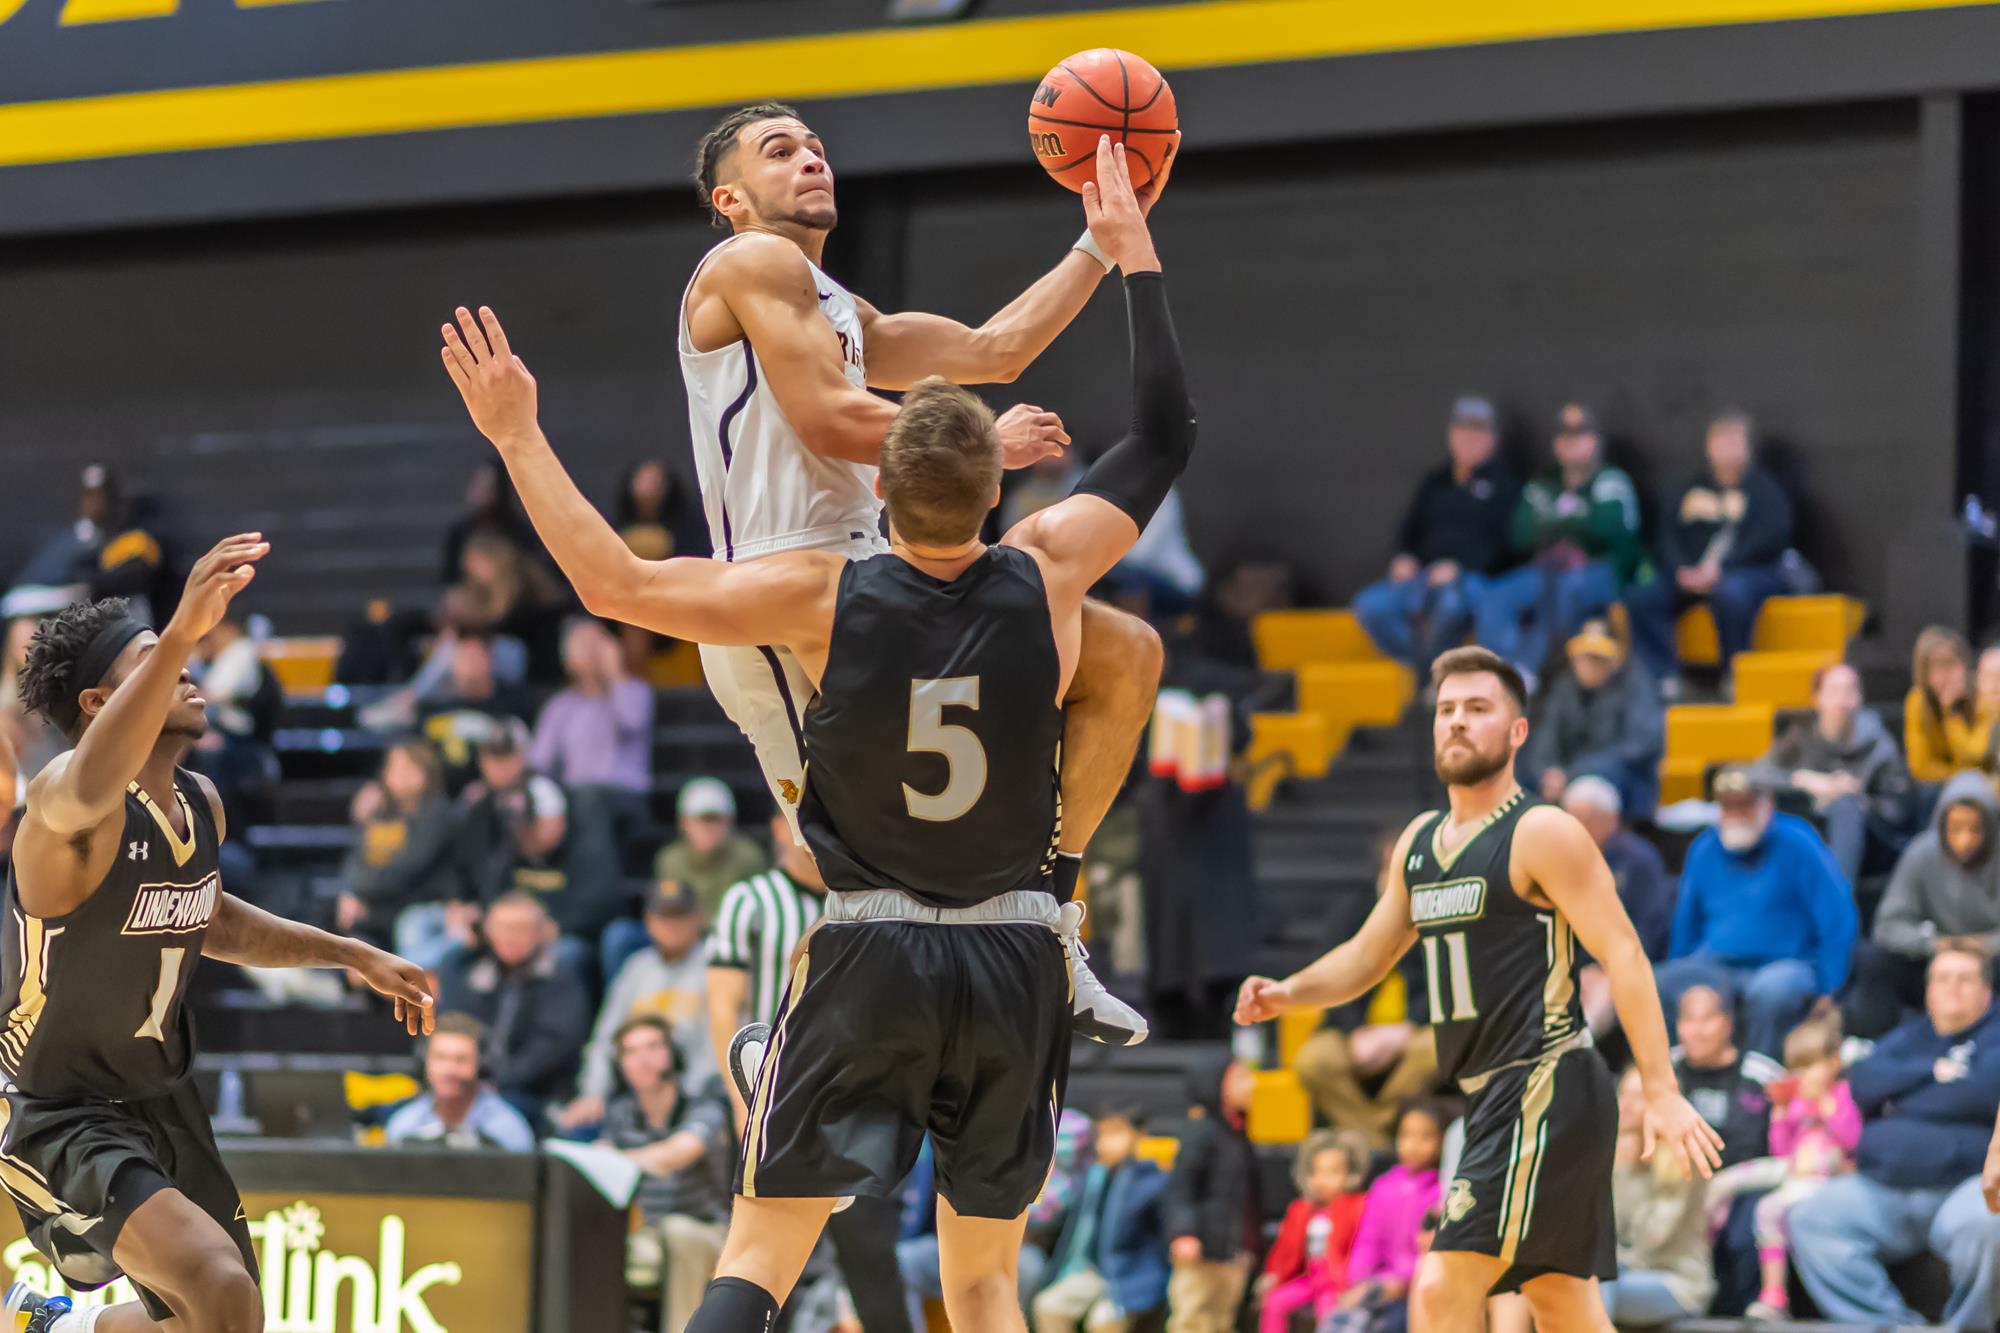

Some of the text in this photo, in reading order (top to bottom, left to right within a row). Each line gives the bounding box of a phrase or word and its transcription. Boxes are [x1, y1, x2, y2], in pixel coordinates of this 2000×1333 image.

[902, 675, 988, 822] 5
[134, 948, 186, 1042] 1
[1422, 931, 1479, 1024] 11
